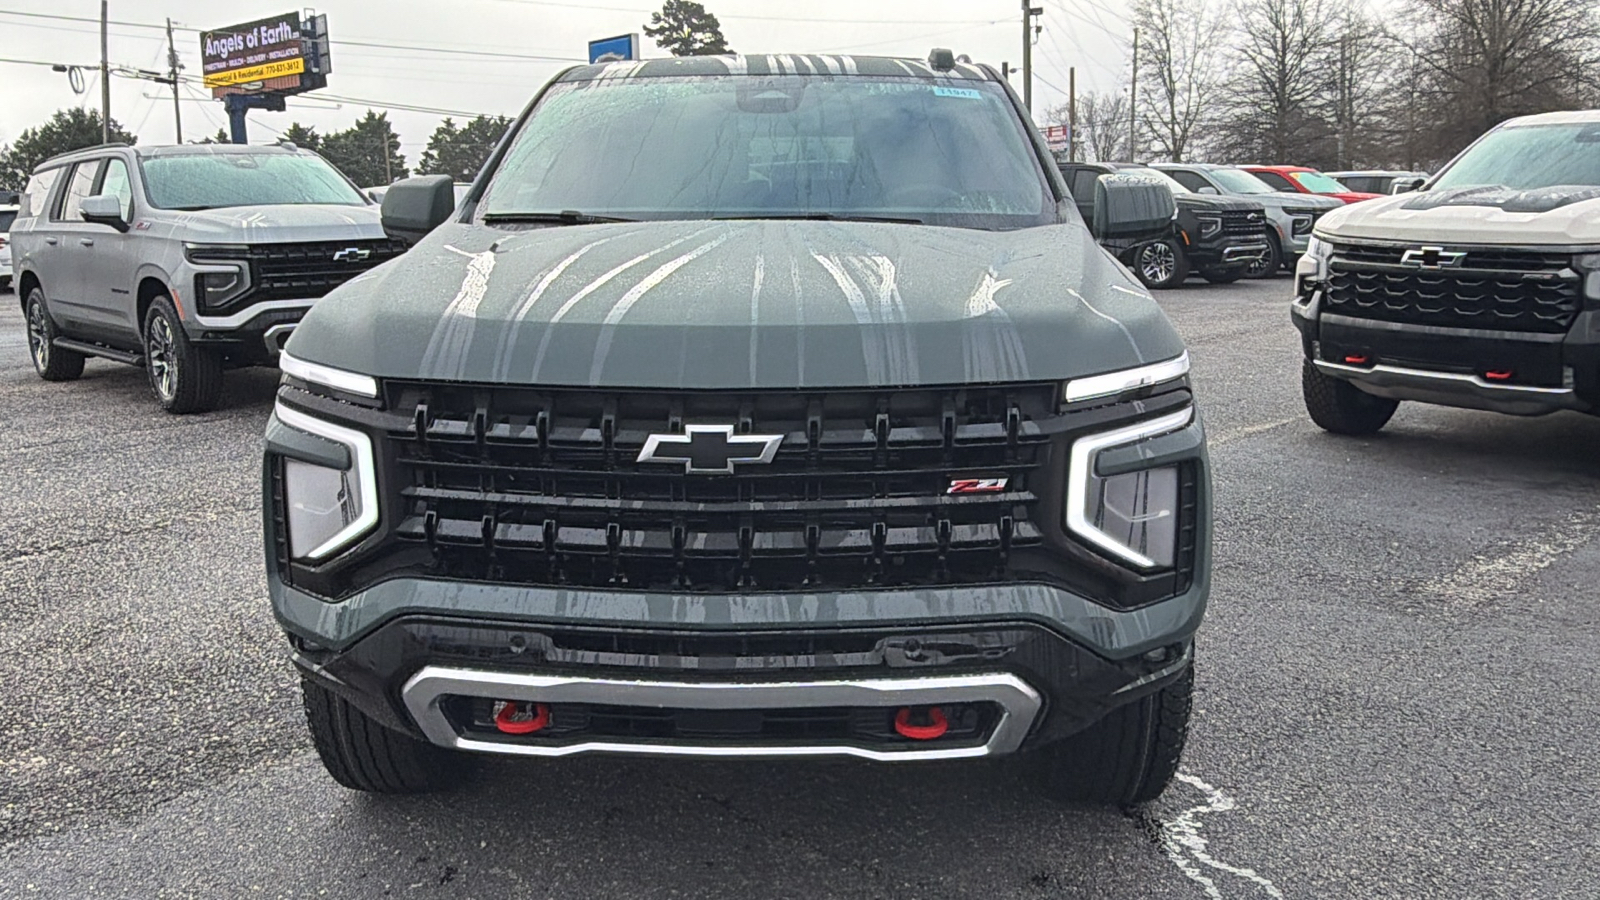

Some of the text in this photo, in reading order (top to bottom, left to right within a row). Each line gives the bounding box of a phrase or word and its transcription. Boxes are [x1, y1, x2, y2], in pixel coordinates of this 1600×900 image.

[205, 22, 292, 58] Angels of Earth
[947, 478, 1008, 493] Z71
